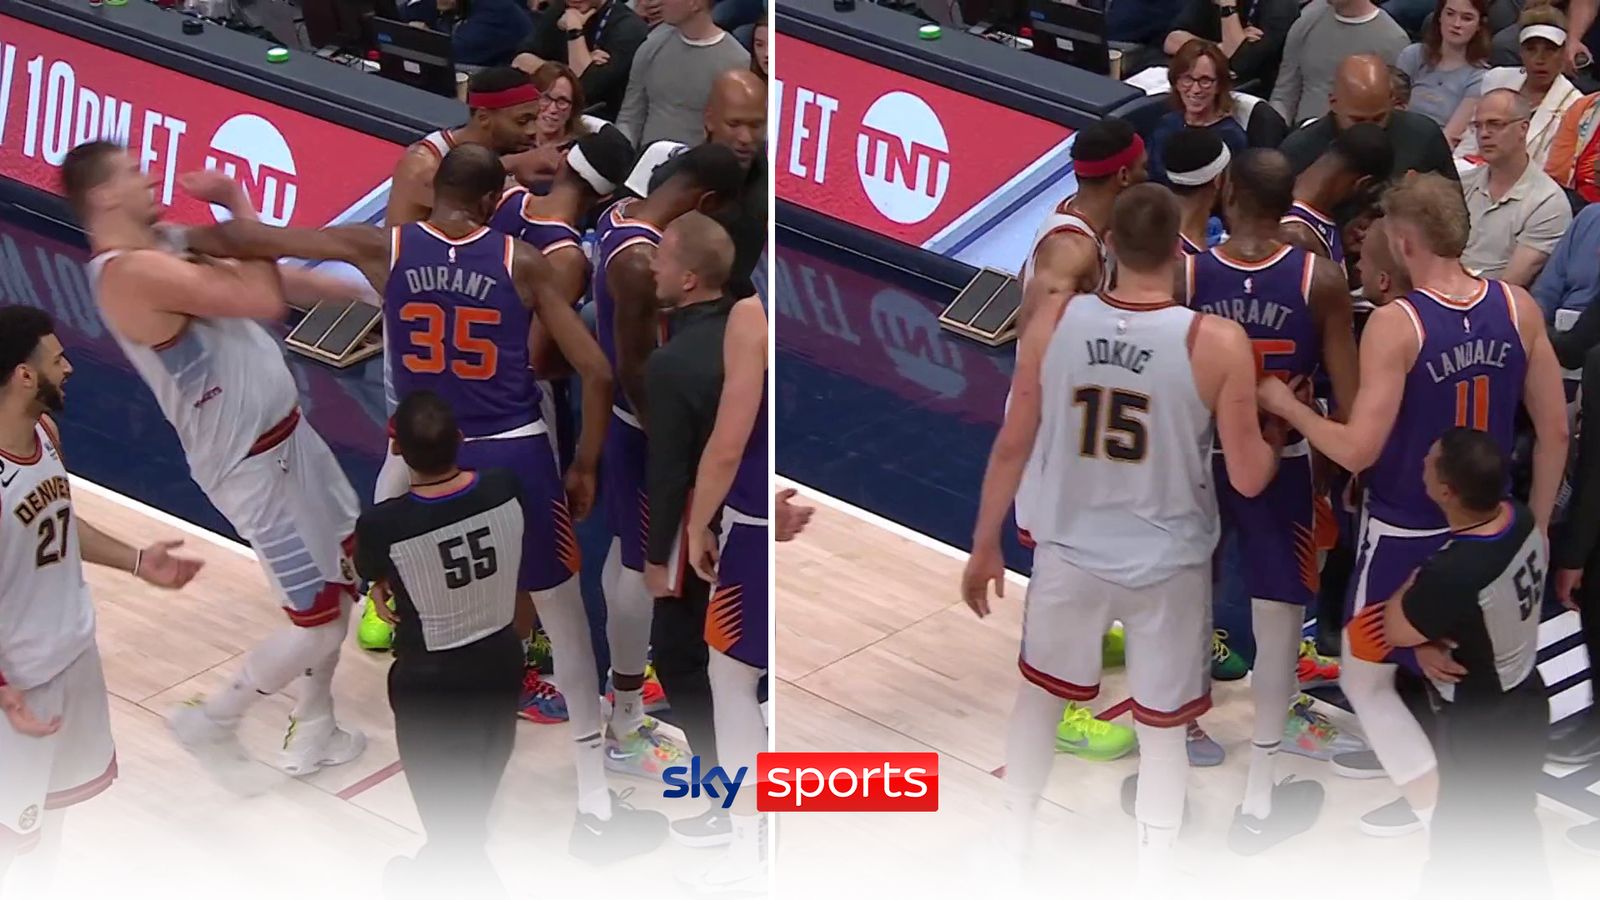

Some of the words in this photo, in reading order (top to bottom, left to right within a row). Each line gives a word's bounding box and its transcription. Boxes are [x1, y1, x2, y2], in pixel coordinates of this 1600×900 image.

[139, 109, 187, 206] ET
[788, 86, 838, 184] ET
[857, 124, 950, 199] TNT
[405, 266, 496, 301] DURANT
[400, 303, 501, 380] 35
[1426, 338, 1512, 383] LANDALE
[1071, 384, 1150, 464] 15
[1455, 374, 1490, 432] 11
[36, 506, 70, 570] 27
[438, 526, 498, 589] 55
